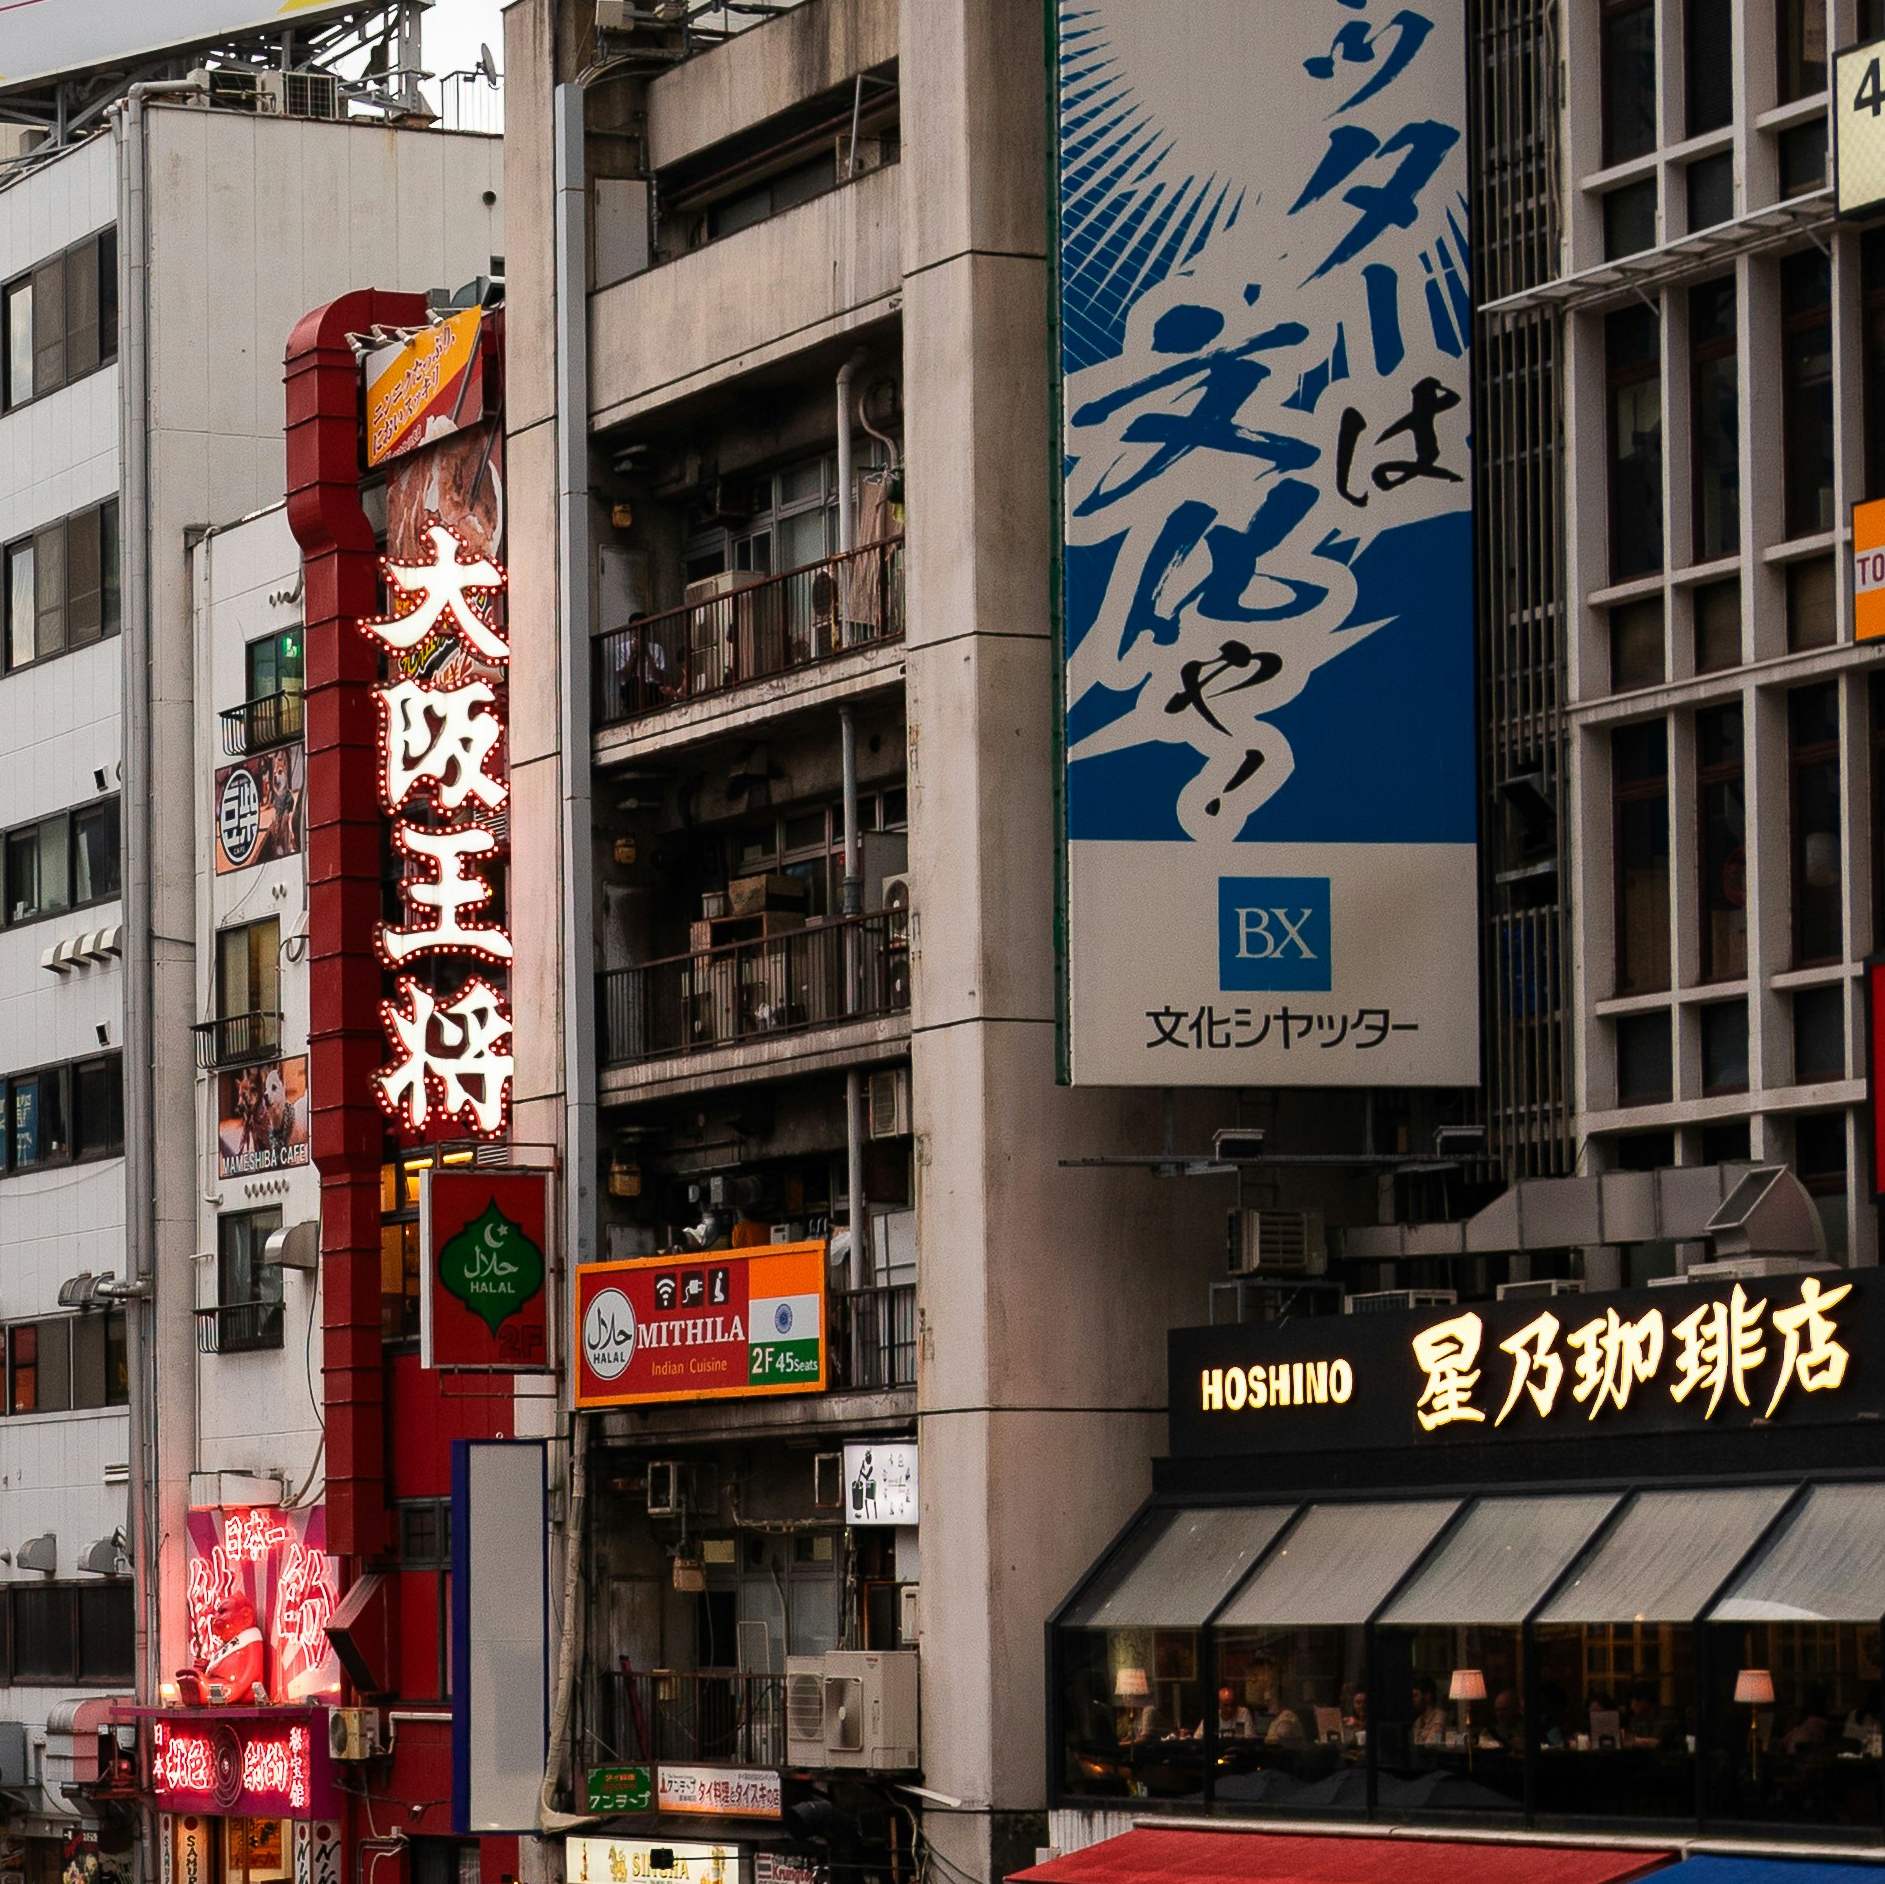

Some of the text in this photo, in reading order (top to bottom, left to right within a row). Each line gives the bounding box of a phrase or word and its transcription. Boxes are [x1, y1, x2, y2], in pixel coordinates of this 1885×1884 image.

[374, 522, 513, 1132] 大阪王将
[1233, 907, 1318, 960] BX
[1143, 1004, 1420, 1049] 文化シャッター
[222, 1143, 306, 1174] MAMESHIBA CAFE
[463, 1244, 519, 1279] حلال
[470, 1281, 516, 1293] HALAL
[498, 1324, 543, 1359] 2F
[586, 1307, 633, 1352] حلال
[636, 1315, 746, 1350] MITHILA
[592, 1351, 626, 1365] HALAL
[651, 1357, 728, 1375] Indian Cuisine
[751, 1346, 774, 1376] 2F
[1411, 1276, 1854, 1433] 星乃珈琲店
[1200, 1357, 1354, 1412] HOSHINO
[224, 1510, 286, 1561] 日本一
[153, 1723, 165, 1794] 日本一
